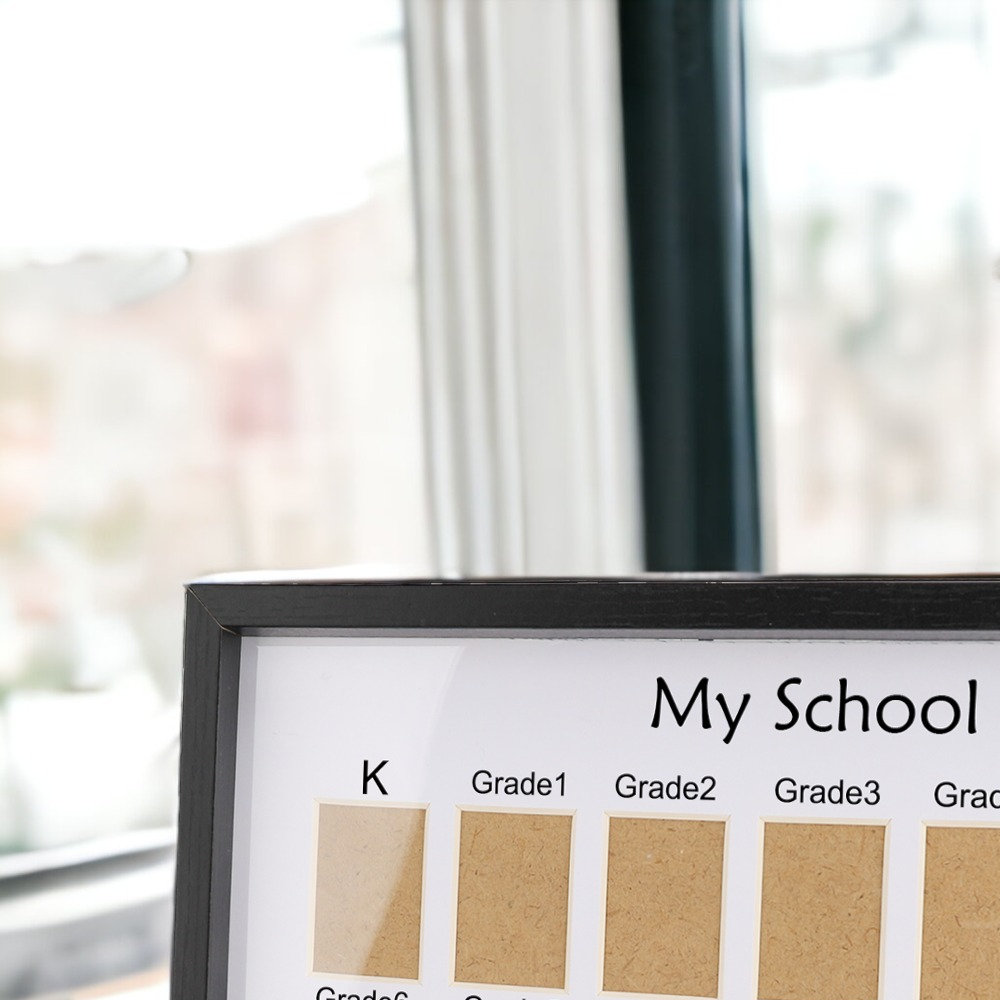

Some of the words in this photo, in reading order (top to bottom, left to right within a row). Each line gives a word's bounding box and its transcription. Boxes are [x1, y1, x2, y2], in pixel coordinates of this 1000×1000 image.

[651, 677, 752, 744] My
[775, 677, 978, 735] School
[362, 759, 389, 796] K
[471, 769, 565, 797] Grade1
[615, 773, 717, 801] Grade2
[774, 777, 881, 806] Grade3
